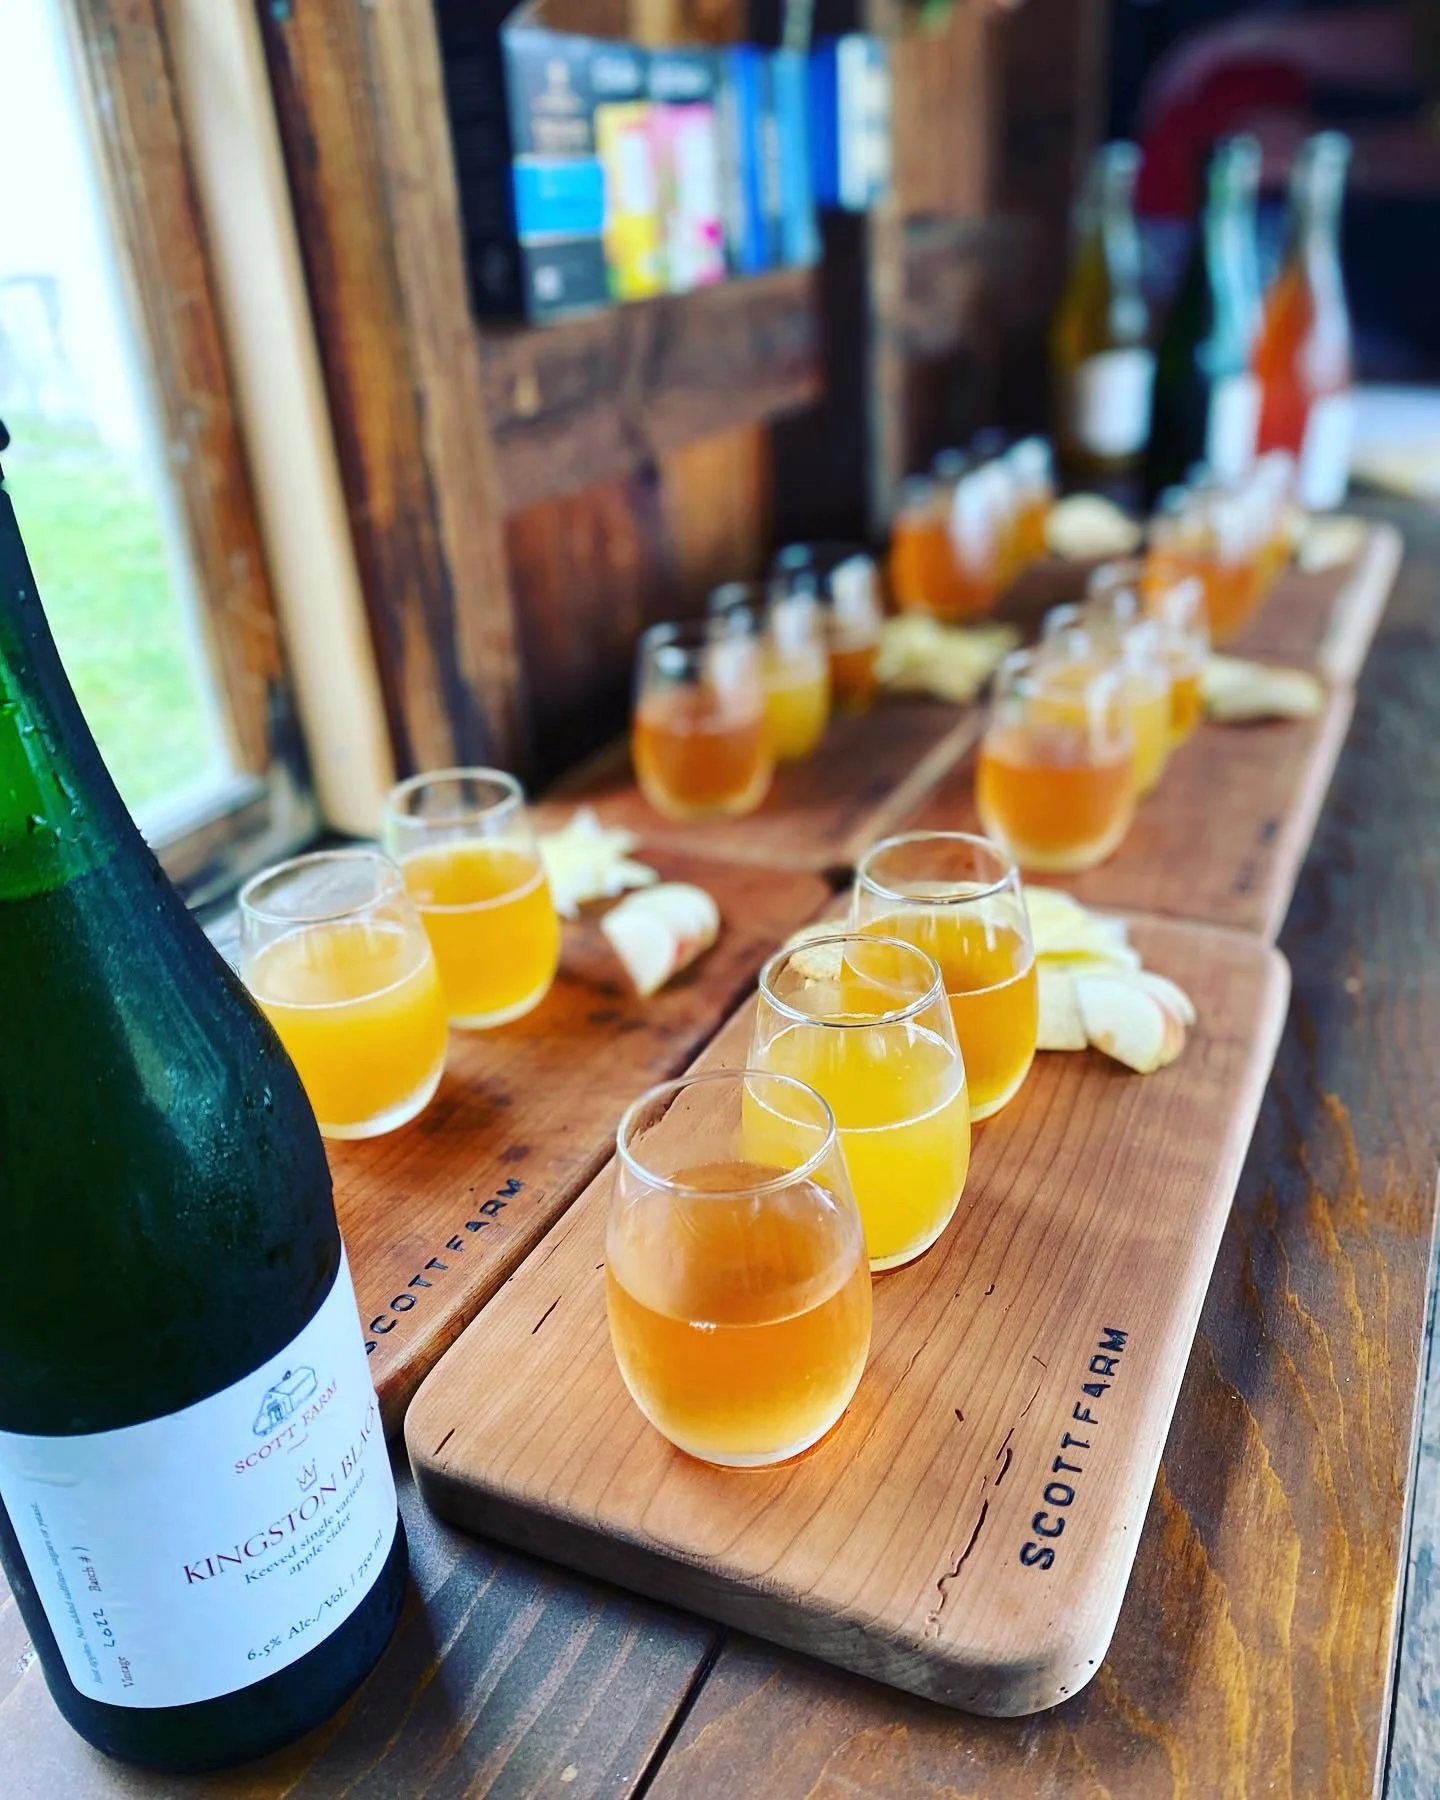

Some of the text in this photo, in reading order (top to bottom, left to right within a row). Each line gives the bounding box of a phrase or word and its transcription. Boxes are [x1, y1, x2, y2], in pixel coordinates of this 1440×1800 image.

[445, 1178, 524, 1253] FARM
[234, 1377, 338, 1475] SCOTT FARM
[1019, 1327, 1129, 1571] SCOTT FARM
[182, 1472, 338, 1585] KINGSTON
[243, 1467, 366, 1585] Keeved single varietal
[288, 1512, 352, 1576] apple cider
[81, 1566, 102, 1592] Batch
[247, 1634, 283, 1661] 6.5%
[287, 1586, 349, 1640] Alc./Vol.
[357, 1551, 374, 1579] 750
[373, 1528, 384, 1552] ml
[92, 1608, 116, 1649] 2022
[117, 1655, 136, 1689] Vintage
